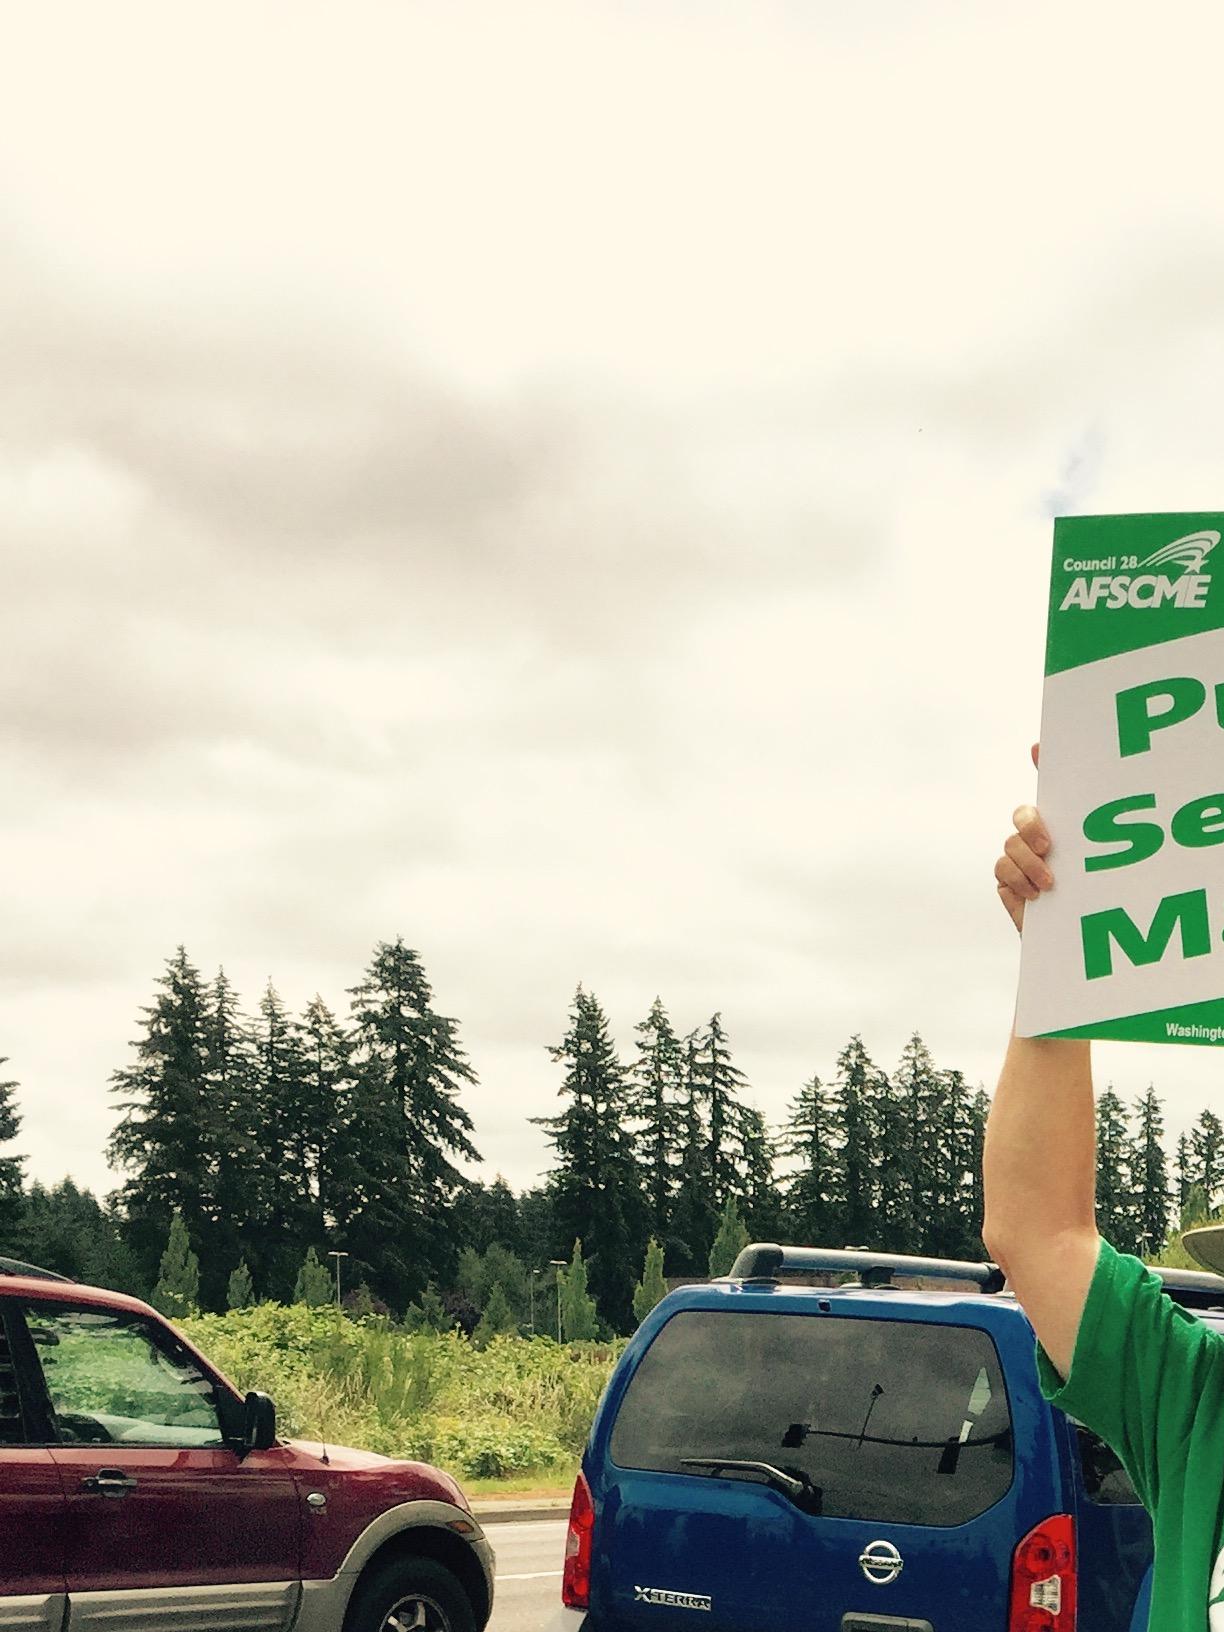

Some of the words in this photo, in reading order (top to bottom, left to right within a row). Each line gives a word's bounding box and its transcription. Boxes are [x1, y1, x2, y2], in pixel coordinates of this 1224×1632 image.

[1063, 556, 1116, 572] Council
[1120, 555, 1138, 570] 28
[1058, 574, 1212, 611] AFSCME
